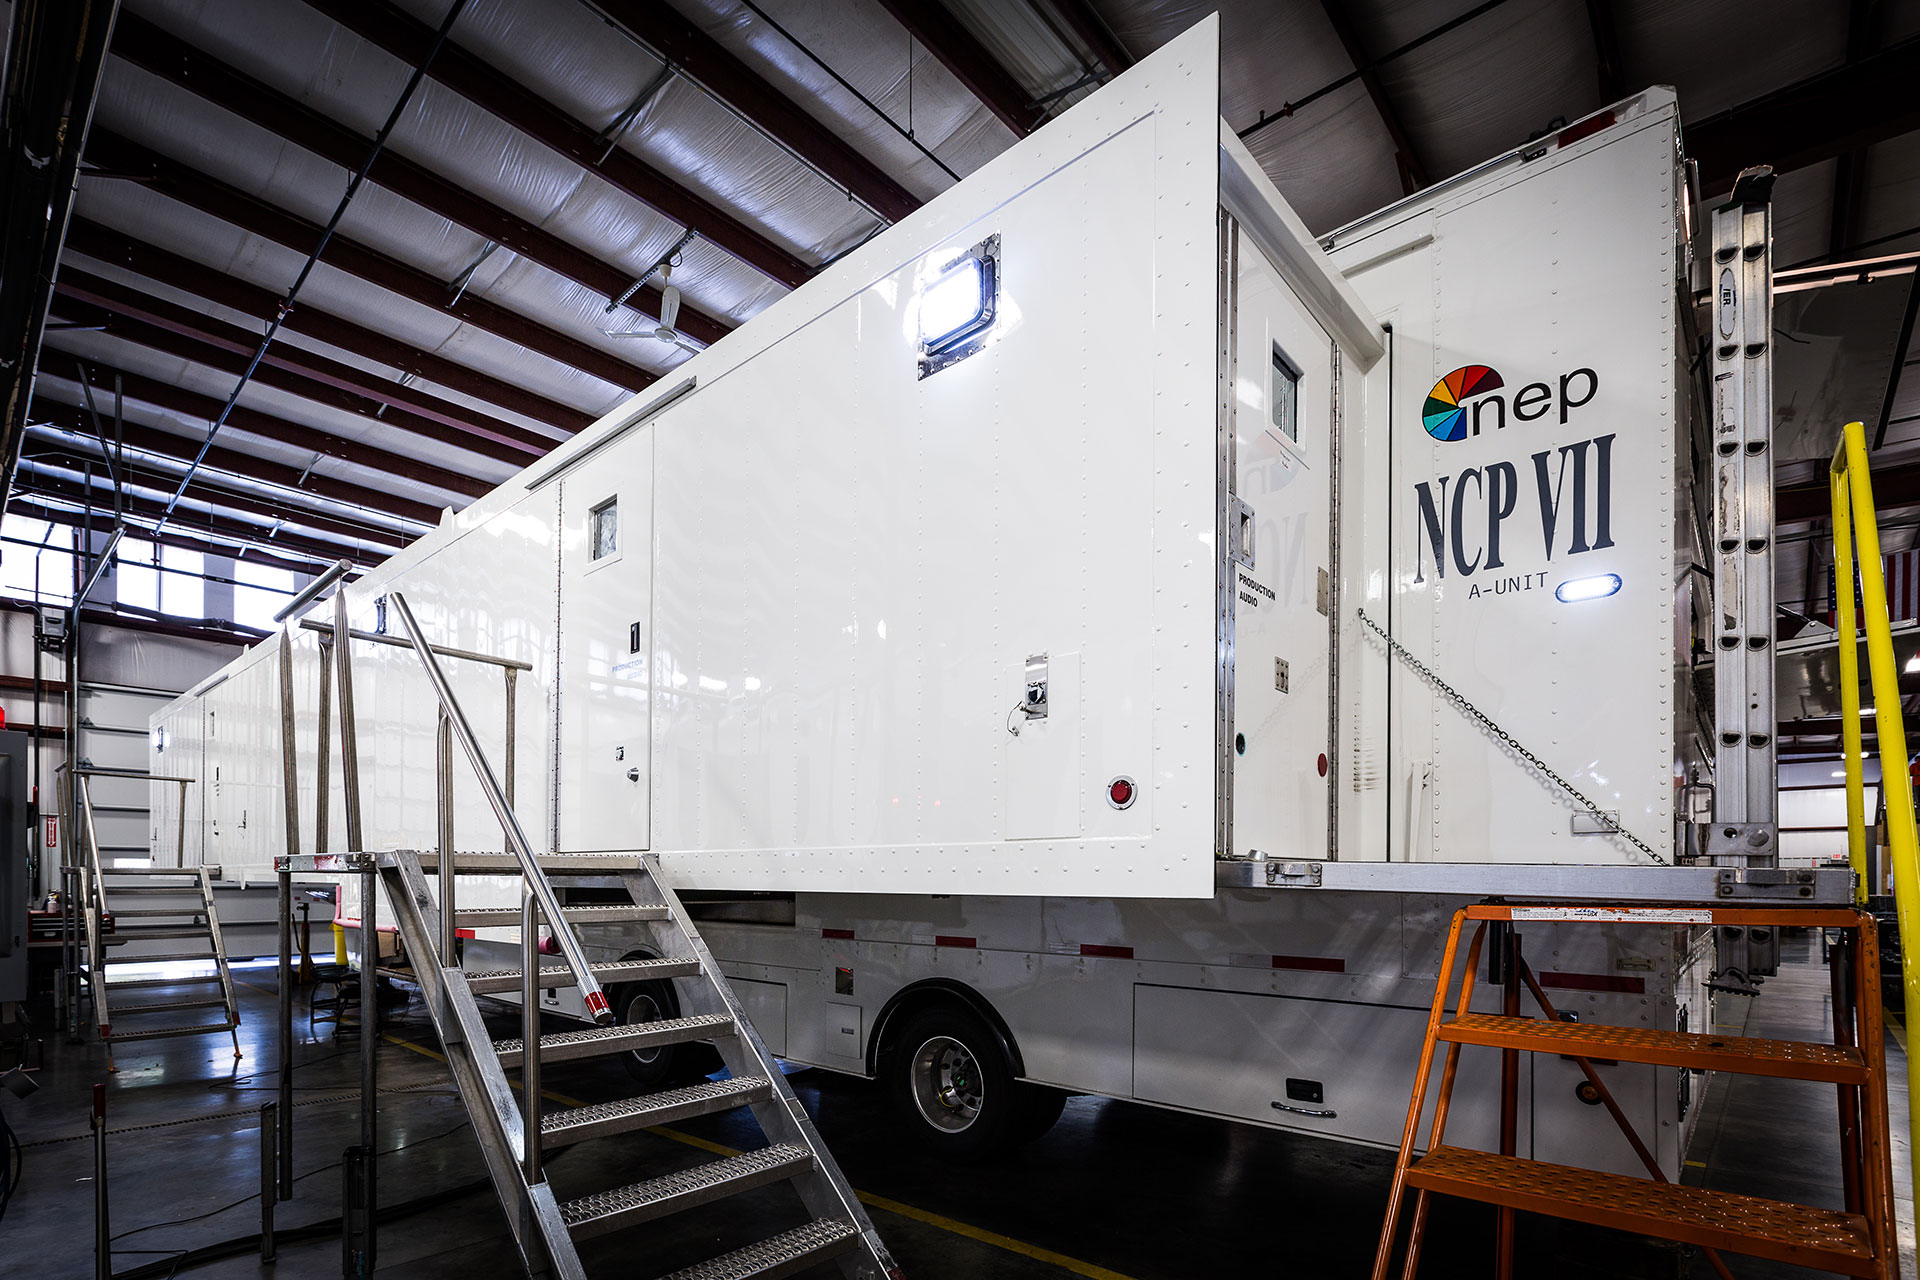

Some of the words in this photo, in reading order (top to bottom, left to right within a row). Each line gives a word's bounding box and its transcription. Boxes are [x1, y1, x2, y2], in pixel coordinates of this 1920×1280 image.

[1472, 367, 1599, 437] nep
[1413, 460, 1518, 584] NCP
[1531, 433, 1617, 562] VII
[1239, 573, 1276, 601] PRODUCTION
[1239, 591, 1258, 607] AUDIO
[1468, 571, 1549, 600] A-UNIT
